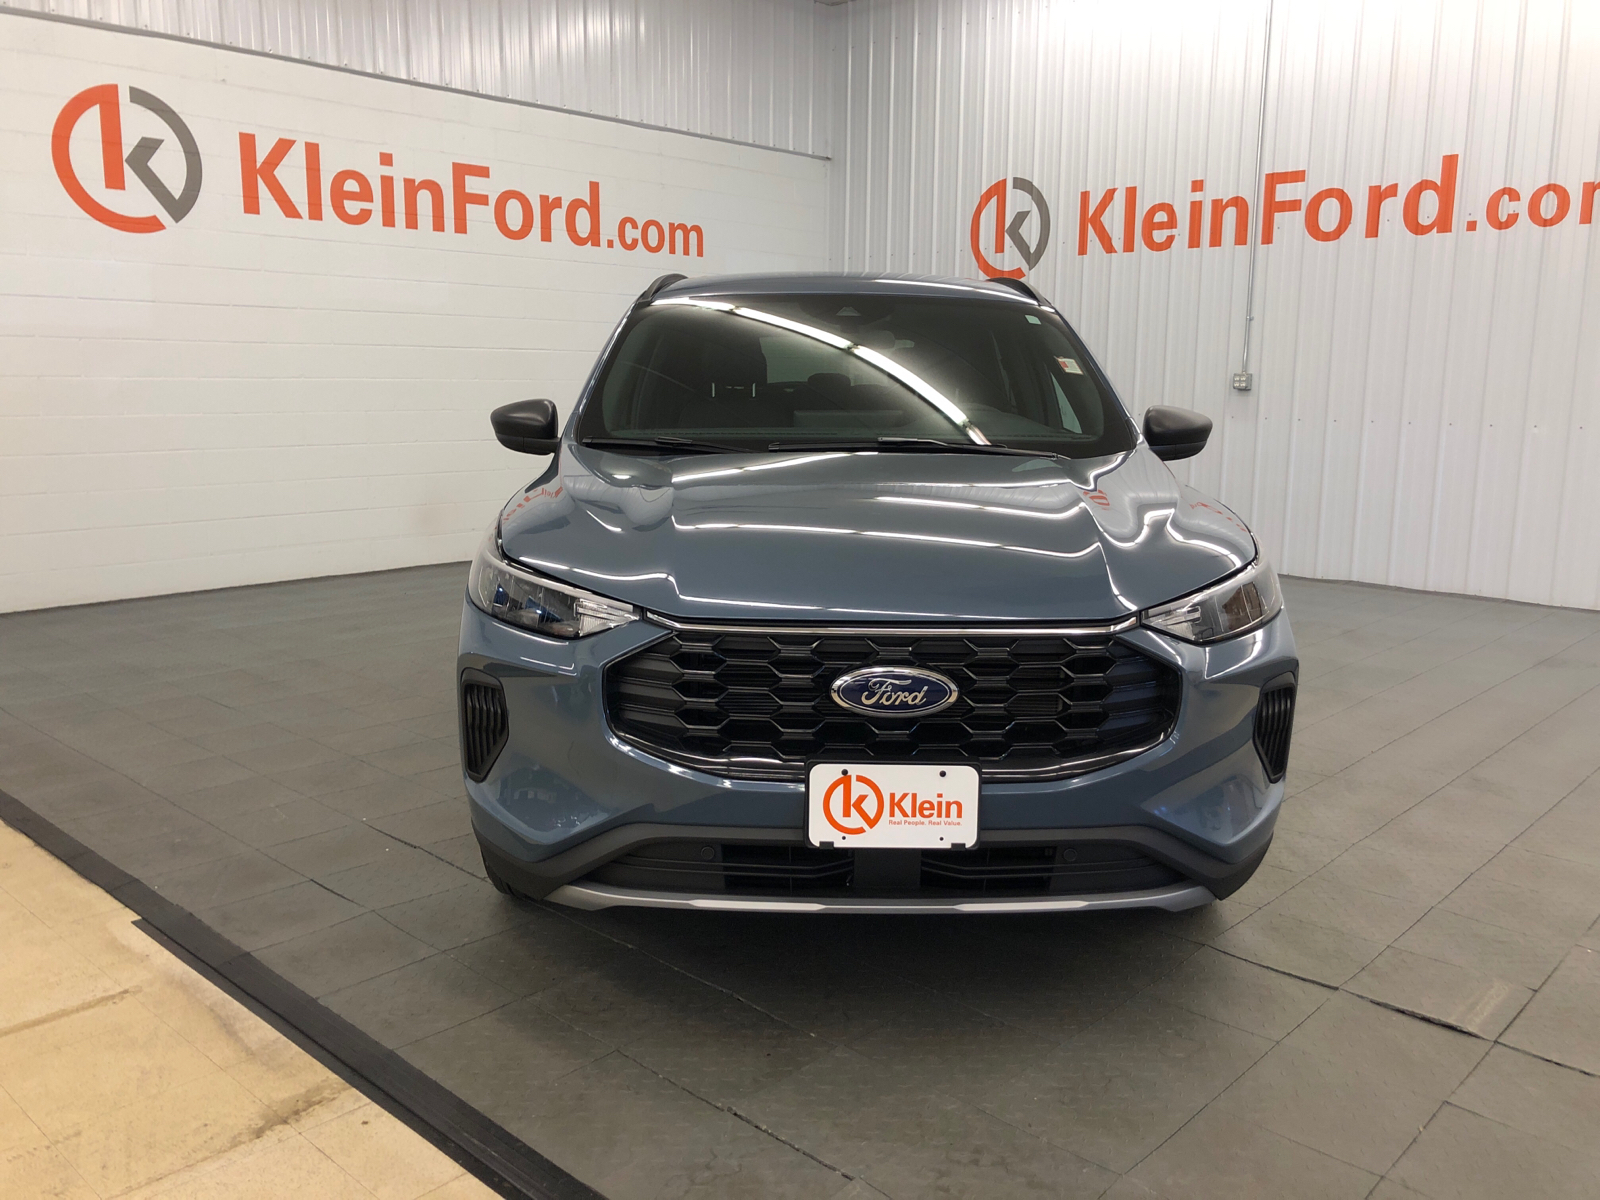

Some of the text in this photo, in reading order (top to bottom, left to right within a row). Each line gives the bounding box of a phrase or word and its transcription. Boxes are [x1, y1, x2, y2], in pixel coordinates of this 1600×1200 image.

[239, 131, 704, 258] KleinFord.com
[861, 677, 928, 706] Ford
[888, 792, 963, 819] Klein
[904, 819, 927, 827] People.
